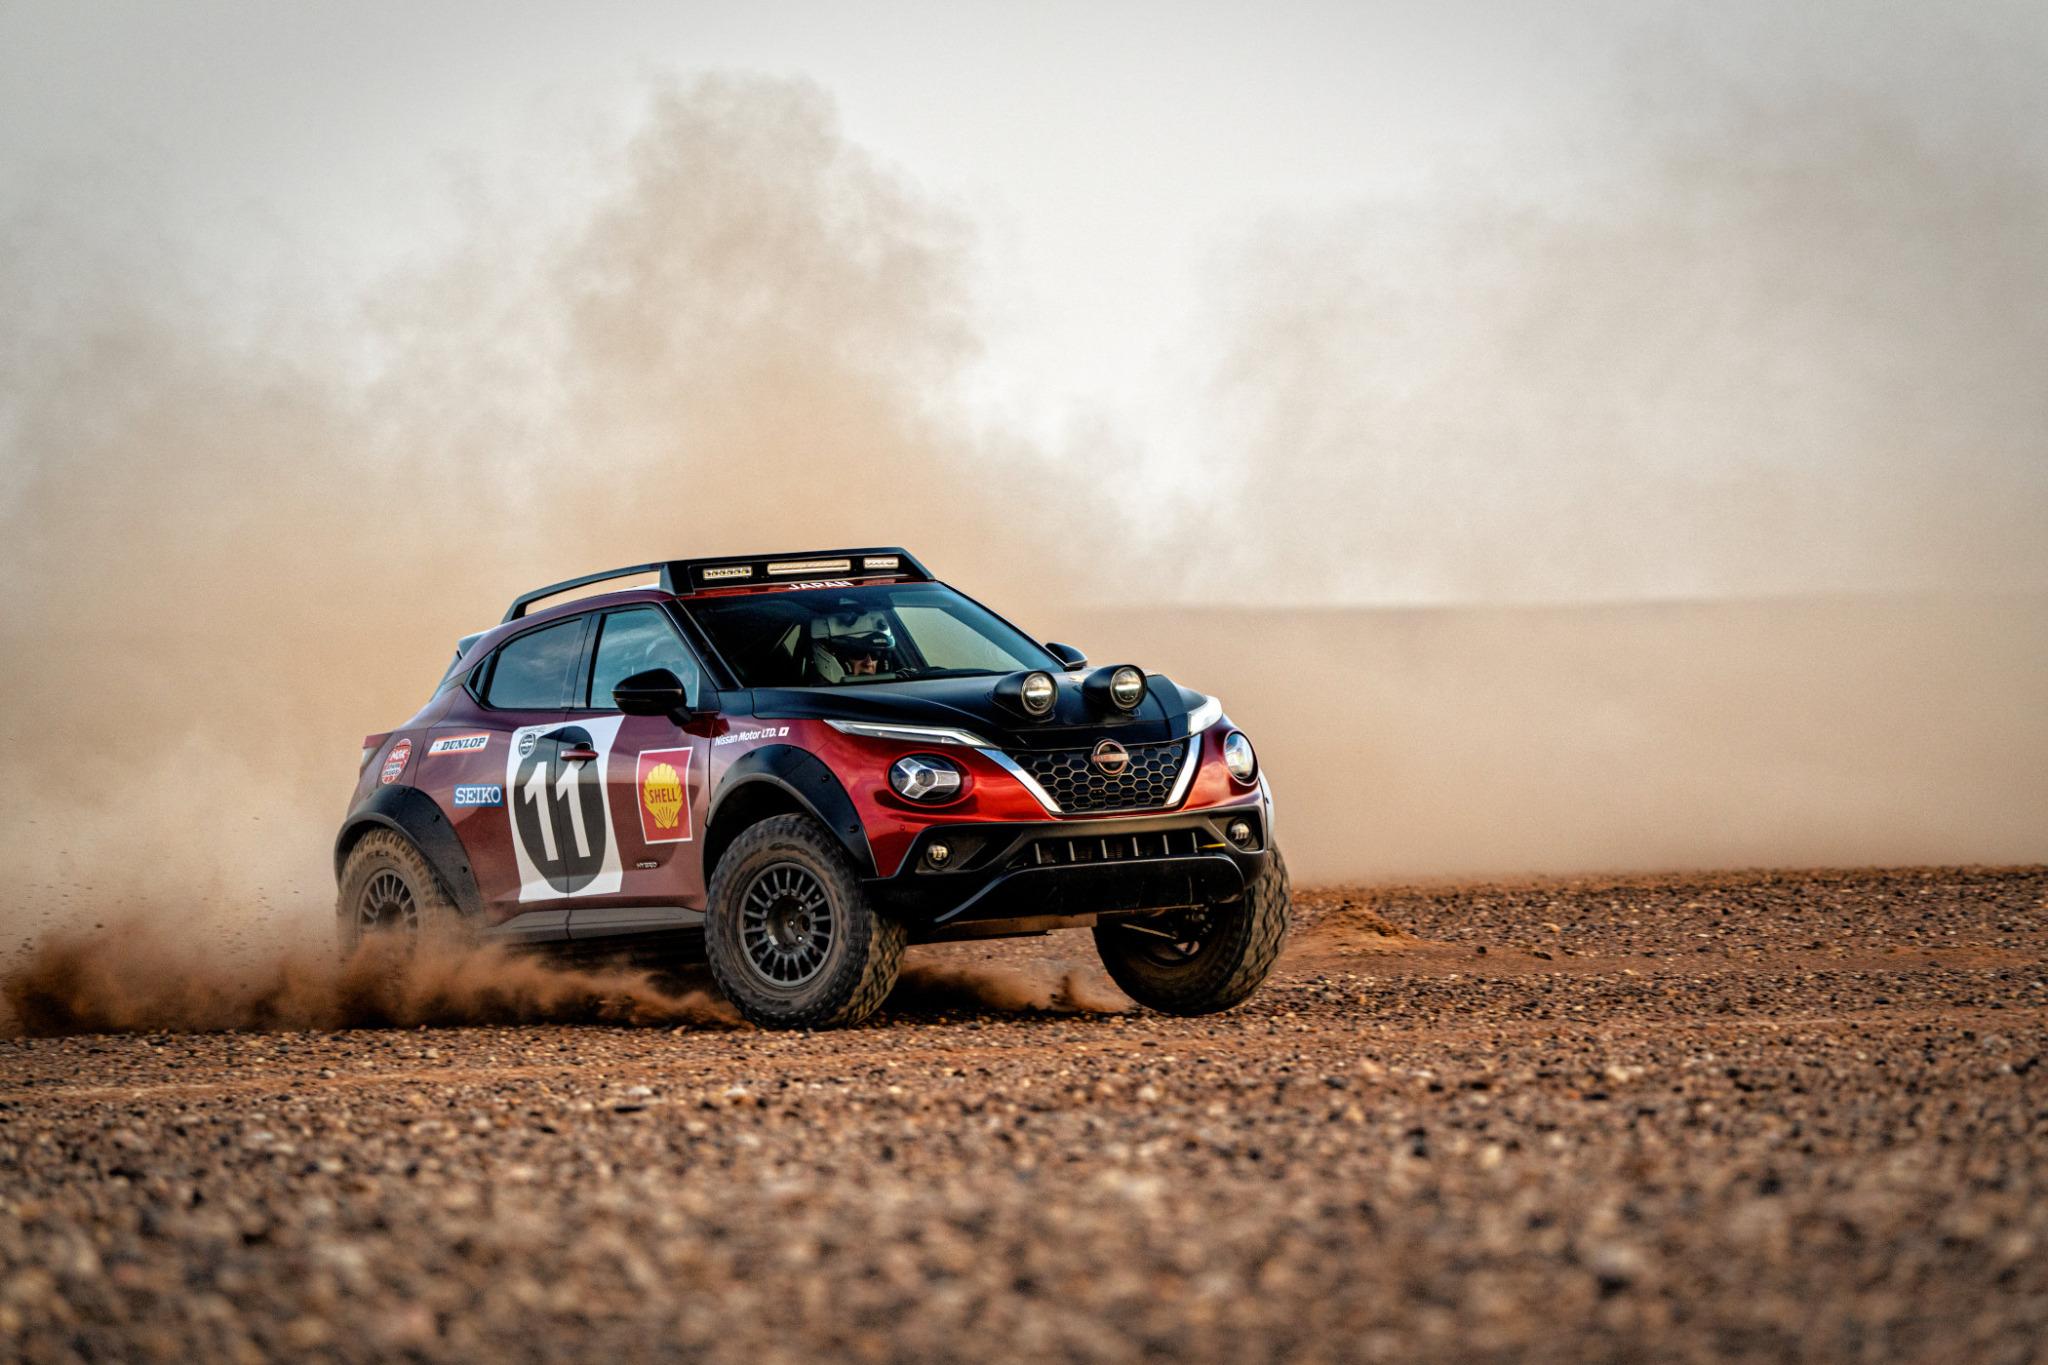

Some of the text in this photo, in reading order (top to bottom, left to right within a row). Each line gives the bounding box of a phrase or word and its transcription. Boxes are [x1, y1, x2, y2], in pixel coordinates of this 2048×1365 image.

[440, 737, 486, 751] DUNLOP
[715, 728, 777, 746] Nissan Motor LTD.
[390, 748, 409, 761] NGK
[454, 786, 502, 804] SEIKO
[649, 787, 678, 804] SHELL
[523, 761, 591, 861] 11
